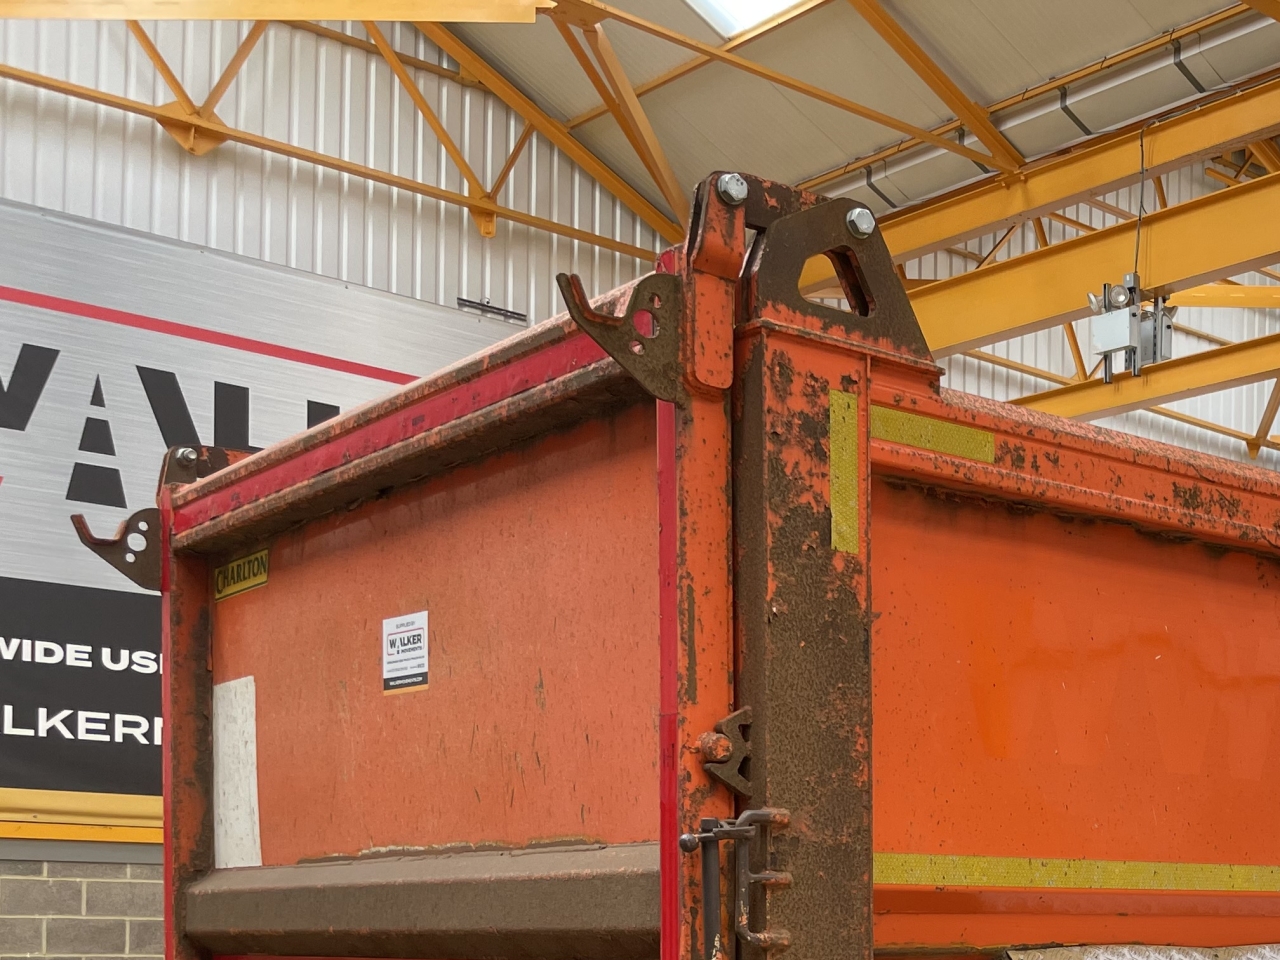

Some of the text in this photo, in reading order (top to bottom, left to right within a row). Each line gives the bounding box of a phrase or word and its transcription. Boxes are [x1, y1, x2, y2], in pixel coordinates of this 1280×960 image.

[216, 554, 268, 595] CHARLTON
[389, 633, 422, 651] WALKER
[401, 646, 423, 655] MOVEMENTS
[101, 647, 162, 674] US
